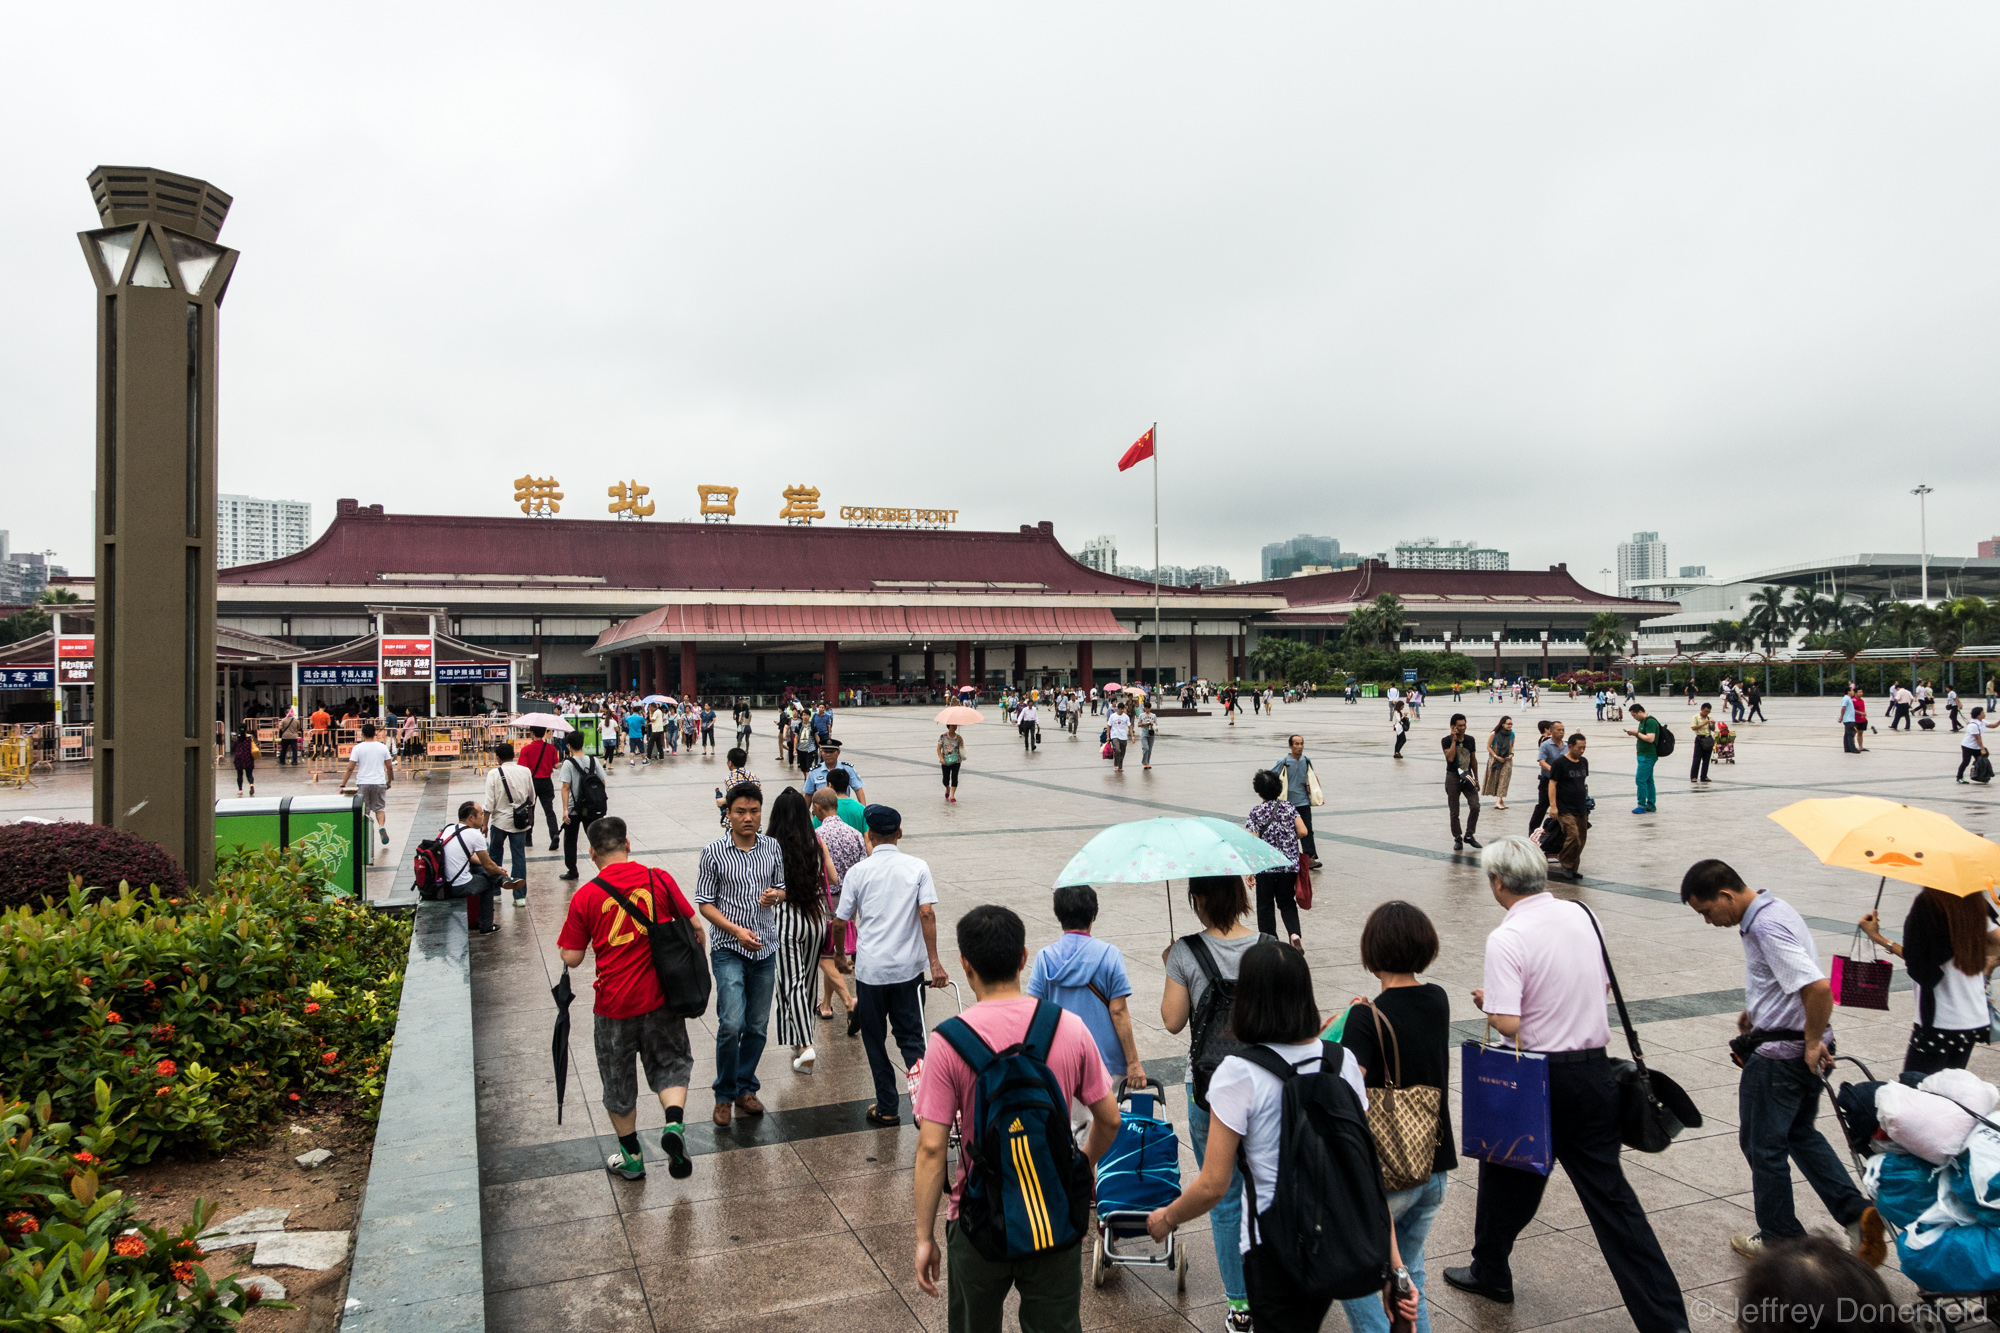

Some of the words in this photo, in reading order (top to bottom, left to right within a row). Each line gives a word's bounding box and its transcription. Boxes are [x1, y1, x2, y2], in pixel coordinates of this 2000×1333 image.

[514, 474, 825, 524] 拱北口岸
[840, 506, 911, 522] GONGBEI
[916, 509, 959, 523] PORT
[304, 670, 337, 678] 混合通道
[341, 670, 374, 678] 外国人通道
[429, 744, 459, 752] 拱北口岸
[602, 887, 653, 946] 20
